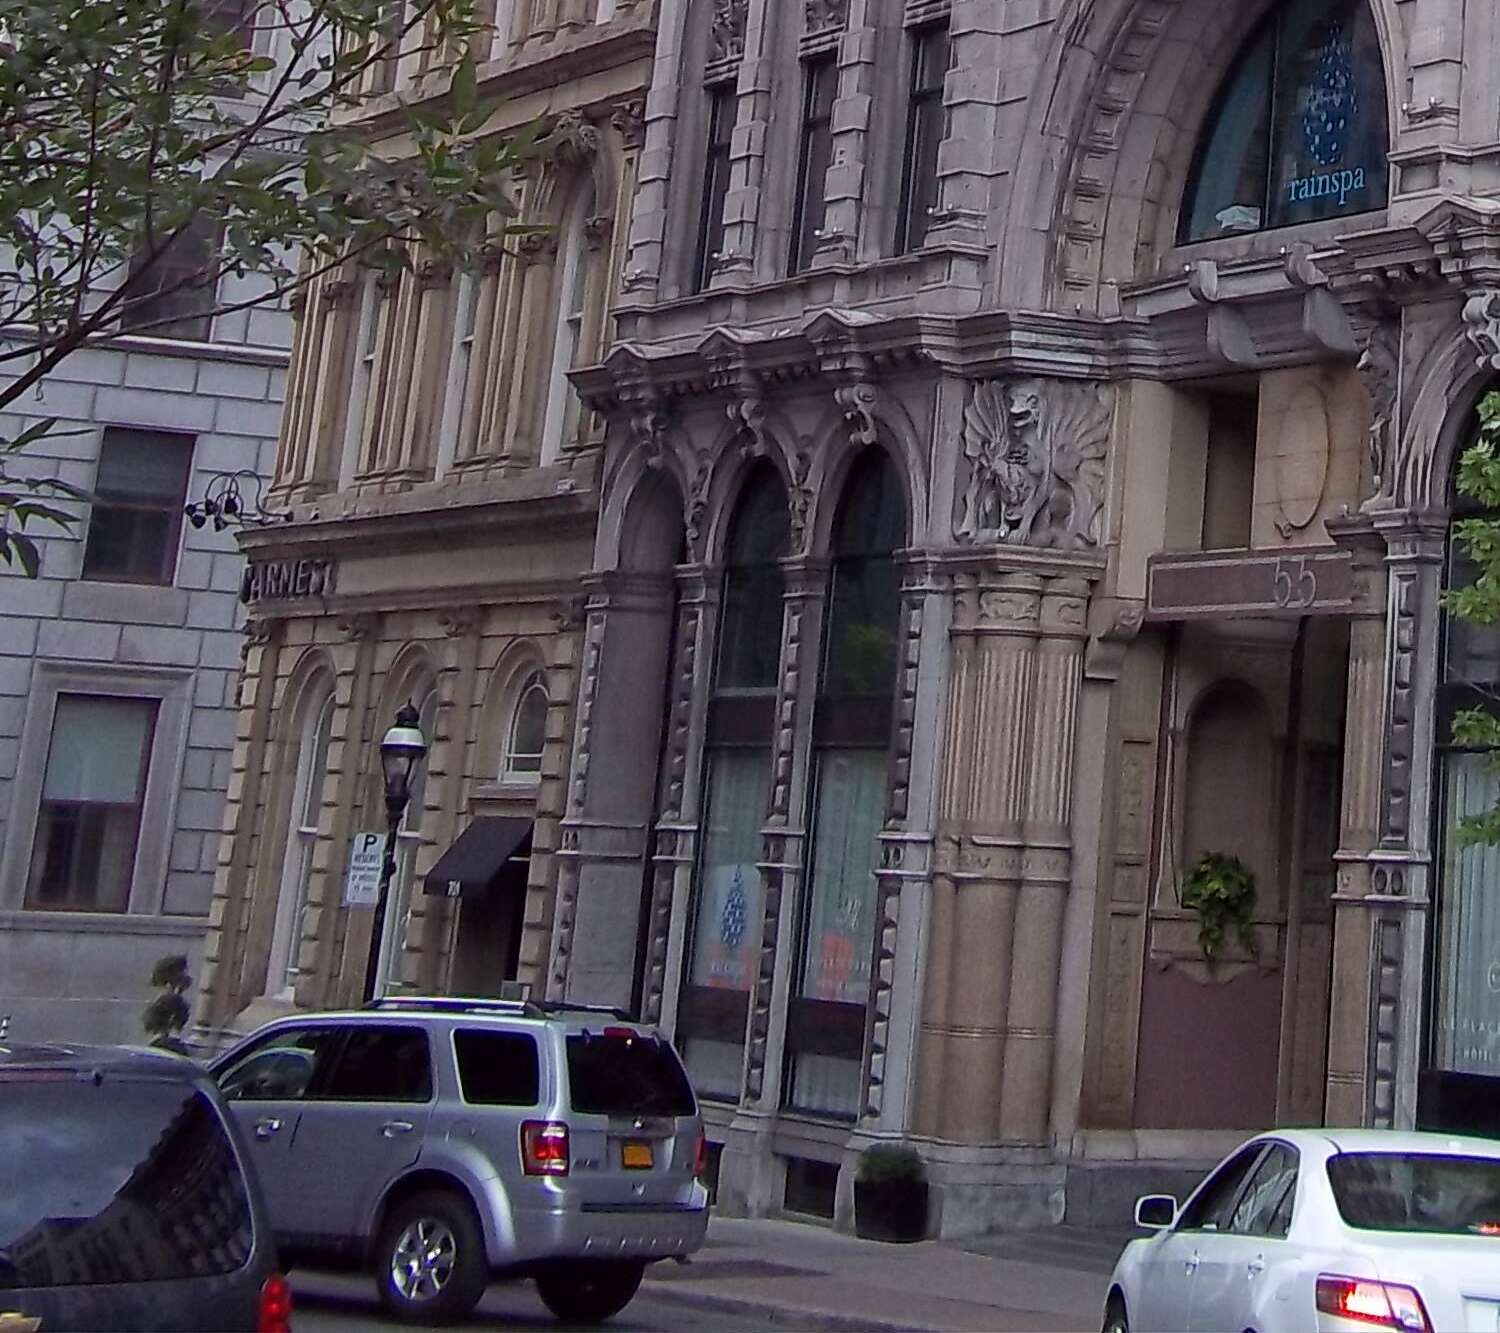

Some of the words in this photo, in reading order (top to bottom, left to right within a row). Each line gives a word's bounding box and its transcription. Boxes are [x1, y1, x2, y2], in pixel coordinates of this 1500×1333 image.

[1288, 167, 1365, 206] rainspa
[1273, 558, 1316, 608] 55
[363, 834, 378, 853] P
